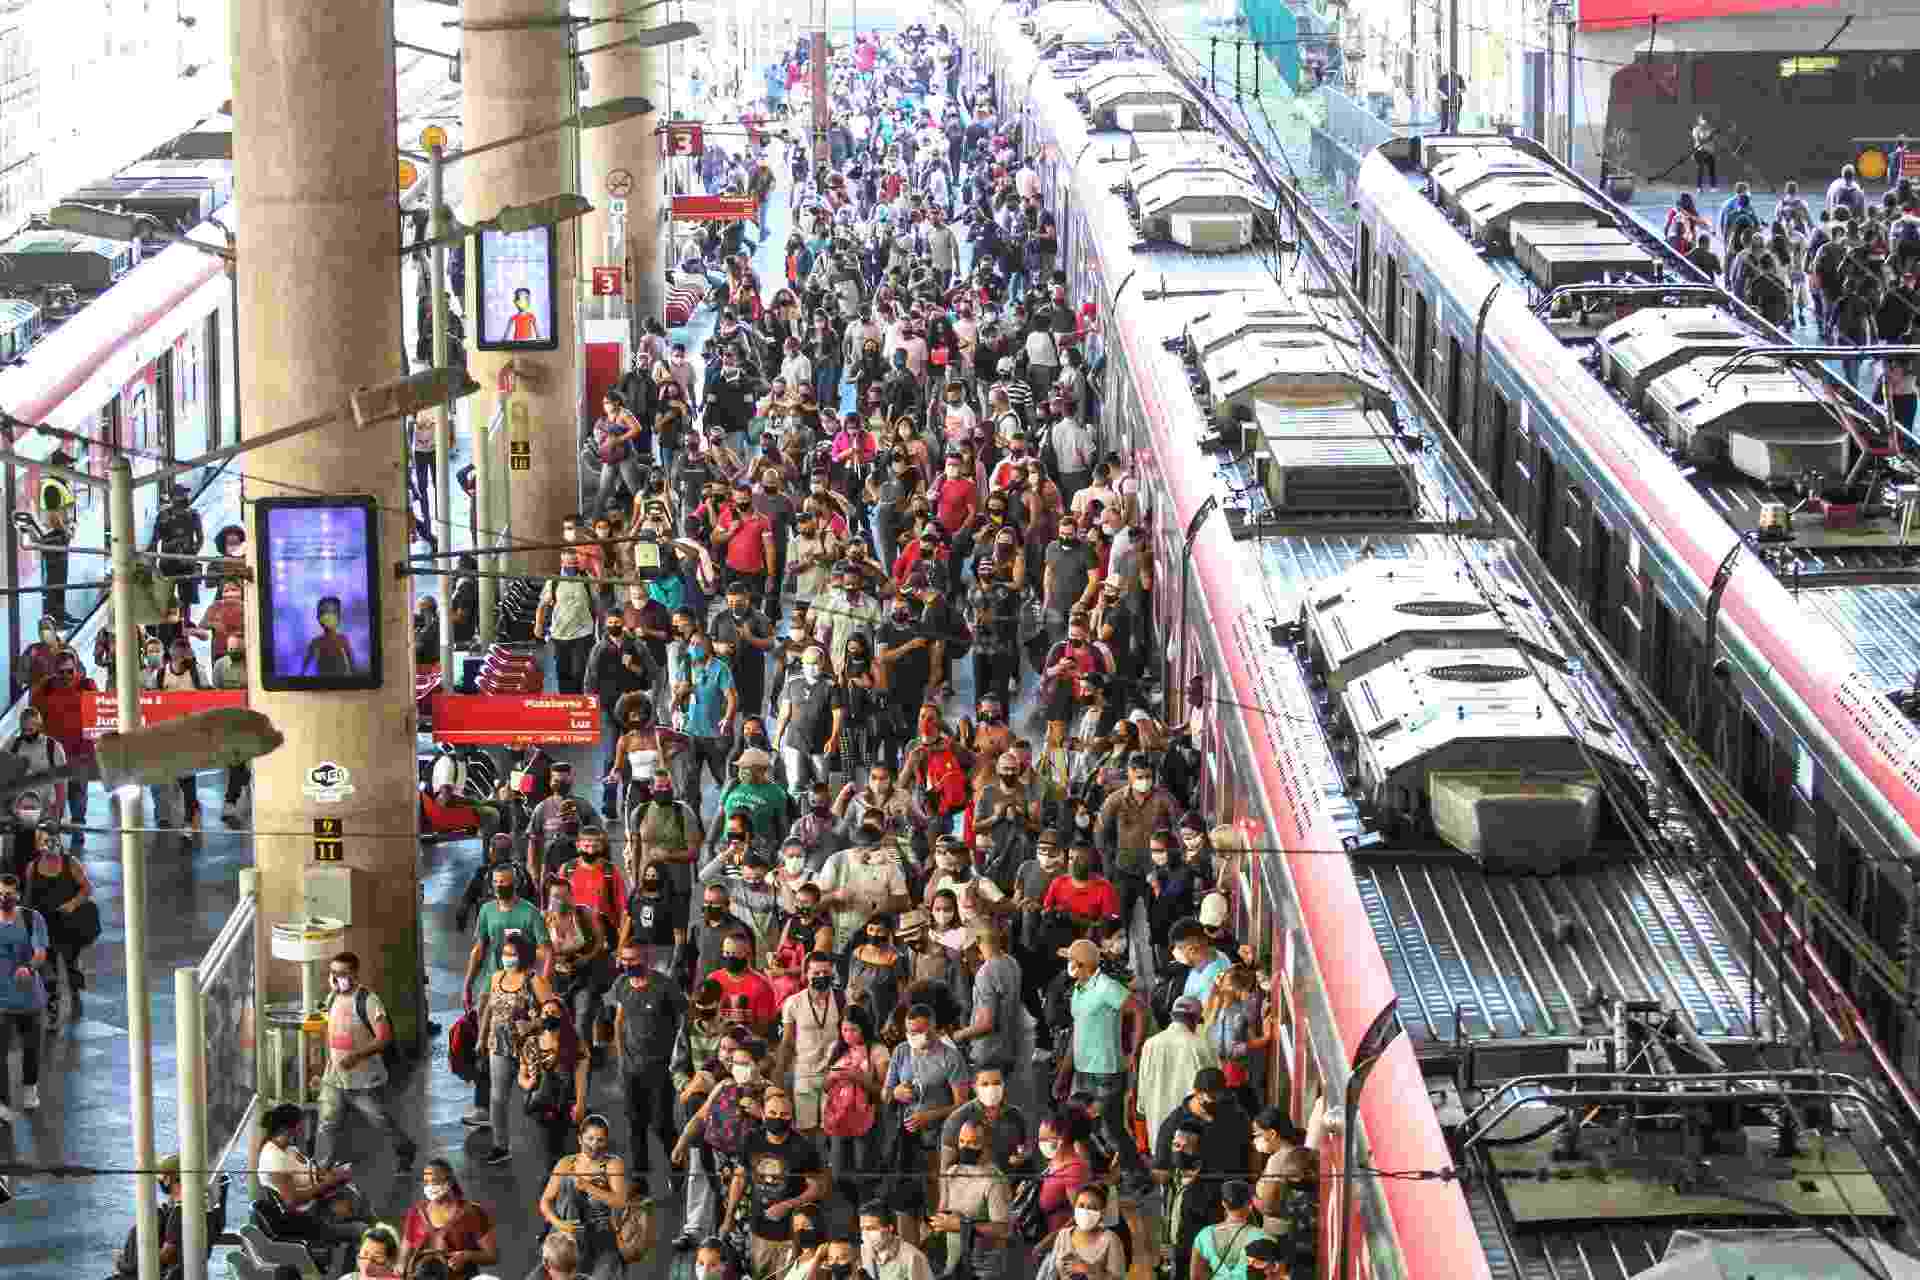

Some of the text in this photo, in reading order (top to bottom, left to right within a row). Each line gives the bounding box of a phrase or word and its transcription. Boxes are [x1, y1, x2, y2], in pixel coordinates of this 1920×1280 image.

[673, 130, 692, 153] 3
[600, 275, 614, 294] 3
[587, 696, 597, 709] 3
[570, 718, 592, 729] Luz
